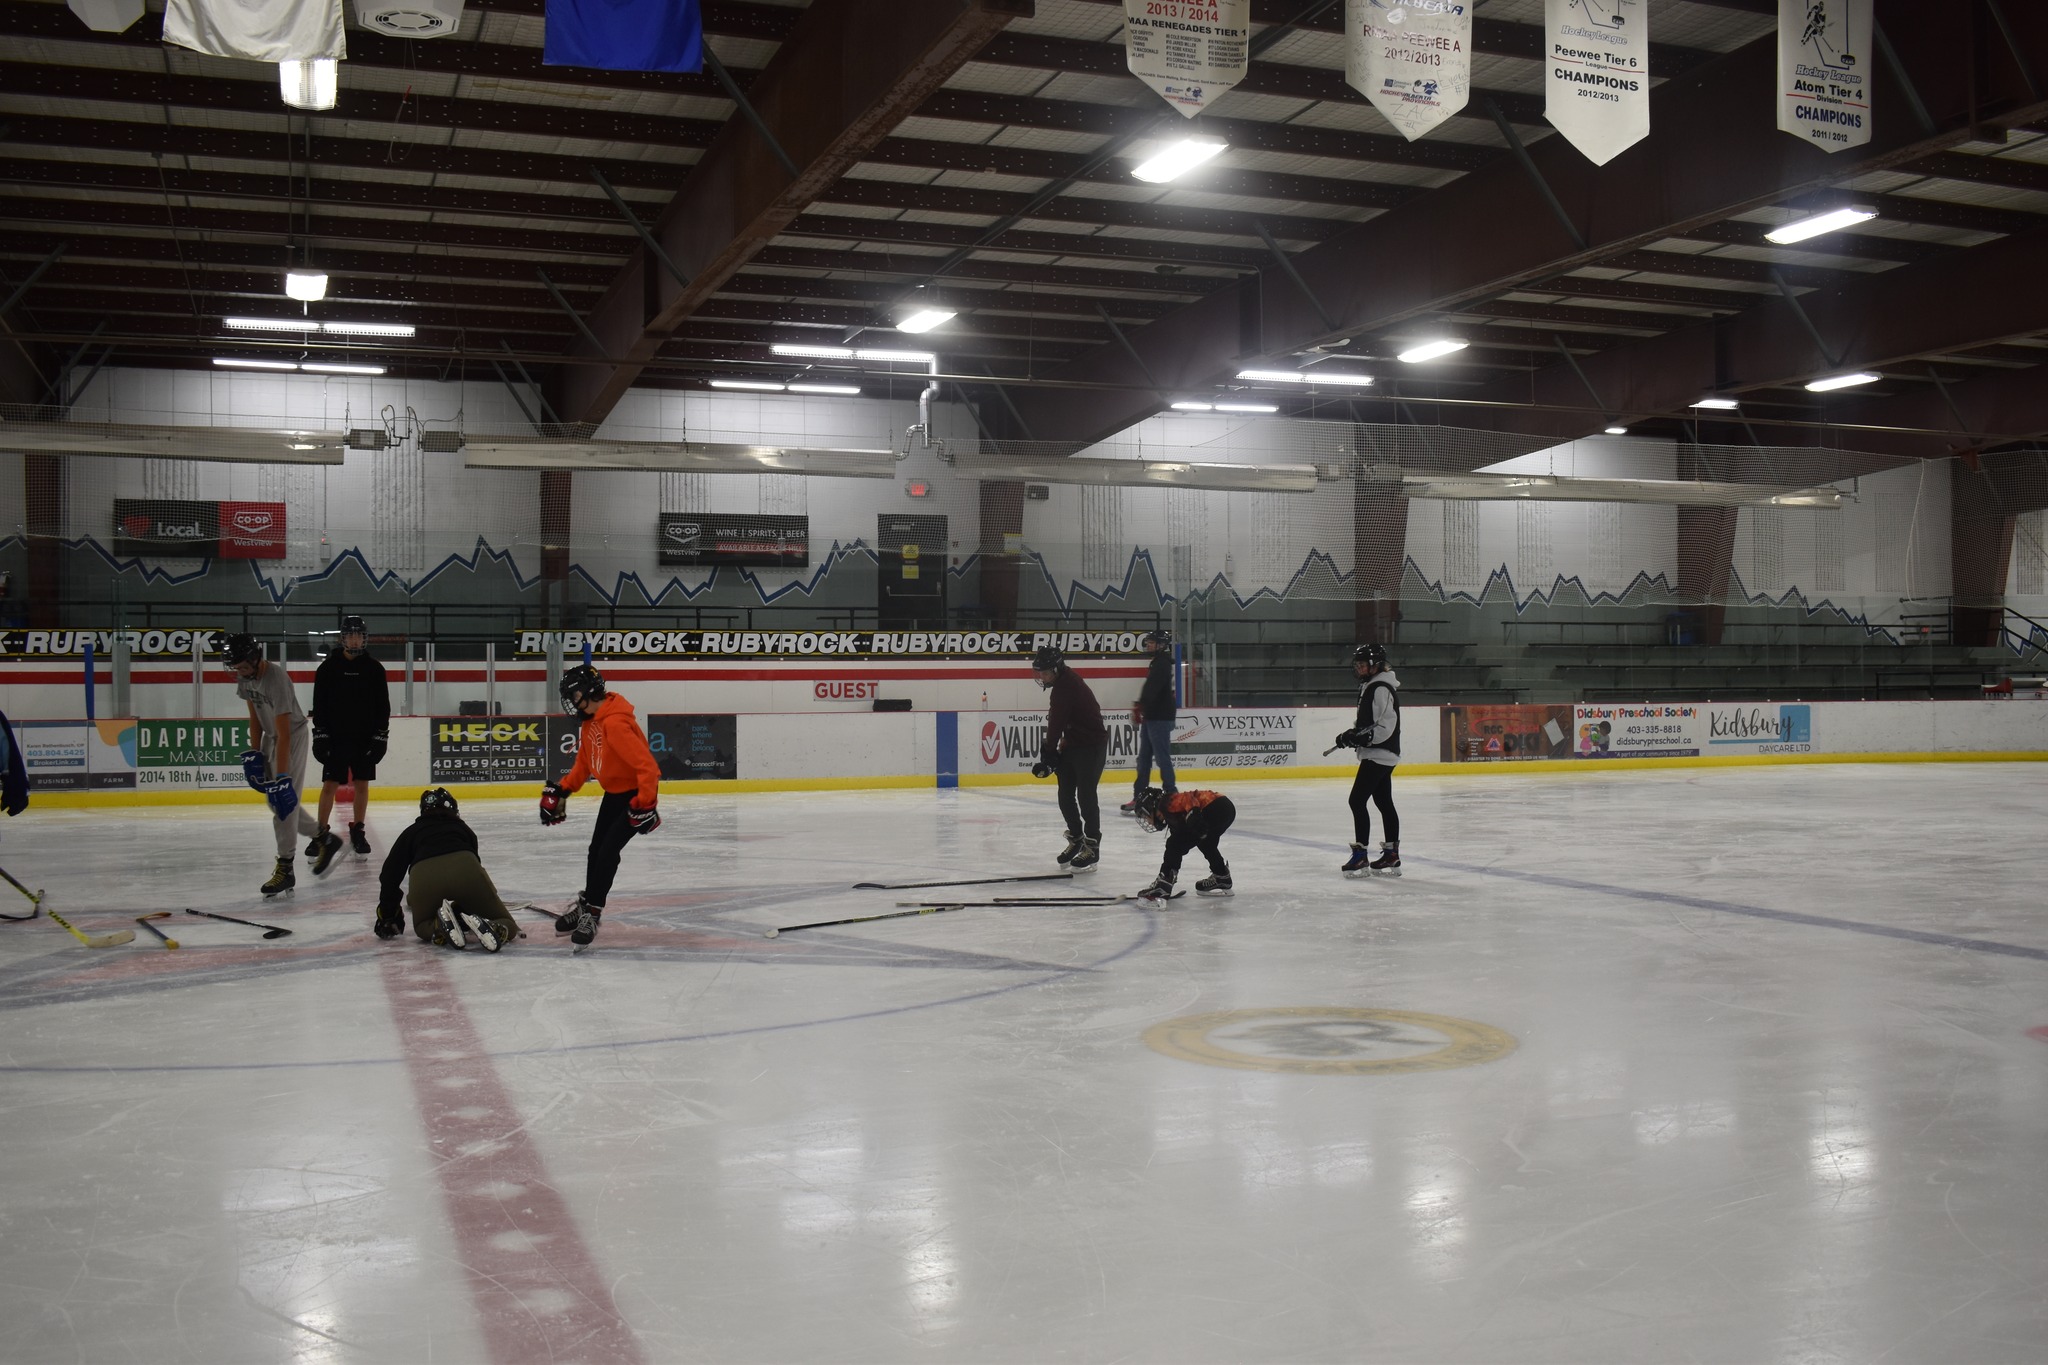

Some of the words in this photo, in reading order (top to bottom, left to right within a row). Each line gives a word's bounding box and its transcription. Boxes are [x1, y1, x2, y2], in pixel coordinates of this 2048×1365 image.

[1146, 2, 1177, 18] 2013
[1189, 7, 1219, 22] 2014
[1151, 19, 1212, 35] RENEGADES
[1214, 27, 1238, 37] TIER
[1561, 25, 1596, 40] Hockey
[1596, 31, 1628, 45] League
[1401, 31, 1450, 51] PEEWEE
[1452, 40, 1461, 53] A
[1384, 46, 1441, 67] 2012/2013
[1555, 44, 1601, 60] Peewee
[1604, 53, 1626, 66] Tier
[1629, 57, 1637, 67] 6
[1585, 61, 1608, 70] League
[1554, 68, 1639, 91] CHAMPIONS
[1795, 64, 1829, 80] Hockey
[1830, 69, 1862, 84] League
[1577, 88, 1619, 102] 2012/2013
[1794, 79, 1825, 94] Atom
[1829, 84, 1852, 98] Tier
[1855, 89, 1863, 100] 4
[1816, 94, 1843, 105] Division
[1795, 104, 1862, 128] CHAMPIONS
[1812, 129, 1828, 139] 2011
[1832, 132, 1848, 142] 2012
[236, 515, 270, 524] CO-OP
[157, 521, 205, 537] Local.
[715, 529, 738, 537] WINE
[747, 529, 777, 538] SPIRITS
[786, 530, 806, 538] BEER
[234, 538, 273, 547] Westview
[666, 548, 701, 556] Westview
[25, 630, 217, 654] RUBYROCK
[520, 631, 688, 653] RUBYROCK
[700, 632, 860, 654] RUBYROCK
[871, 632, 1020, 653] RUBYROCK
[1032, 632, 1149, 653] RUBYROC
[814, 681, 878, 699] GUEST
[1576, 707, 1617, 720] Didsbury
[1619, 706, 1663, 718] Preschool
[1664, 706, 1697, 719] Society
[1207, 715, 1297, 730] WESTWAY
[1626, 725, 1682, 734] 403-335-8818
[1710, 707, 1795, 743] Kidsbury
[439, 723, 540, 742] HECK
[1616, 736, 1692, 747] didsburypreschool.ca
[1758, 744, 1795, 753] DAYCARE
[1796, 744, 1811, 752] LTD
[27, 749, 85, 757] 403.804.5425
[169, 750, 228, 763] MARKET
[1205, 755, 1233, 767] (403)
[1235, 754, 1289, 767] 335-4929
[433, 758, 545, 769] 403-994-0081
[139, 770, 165, 783] 2014
[169, 770, 192, 783] 18th
[195, 770, 218, 783] Ave.
